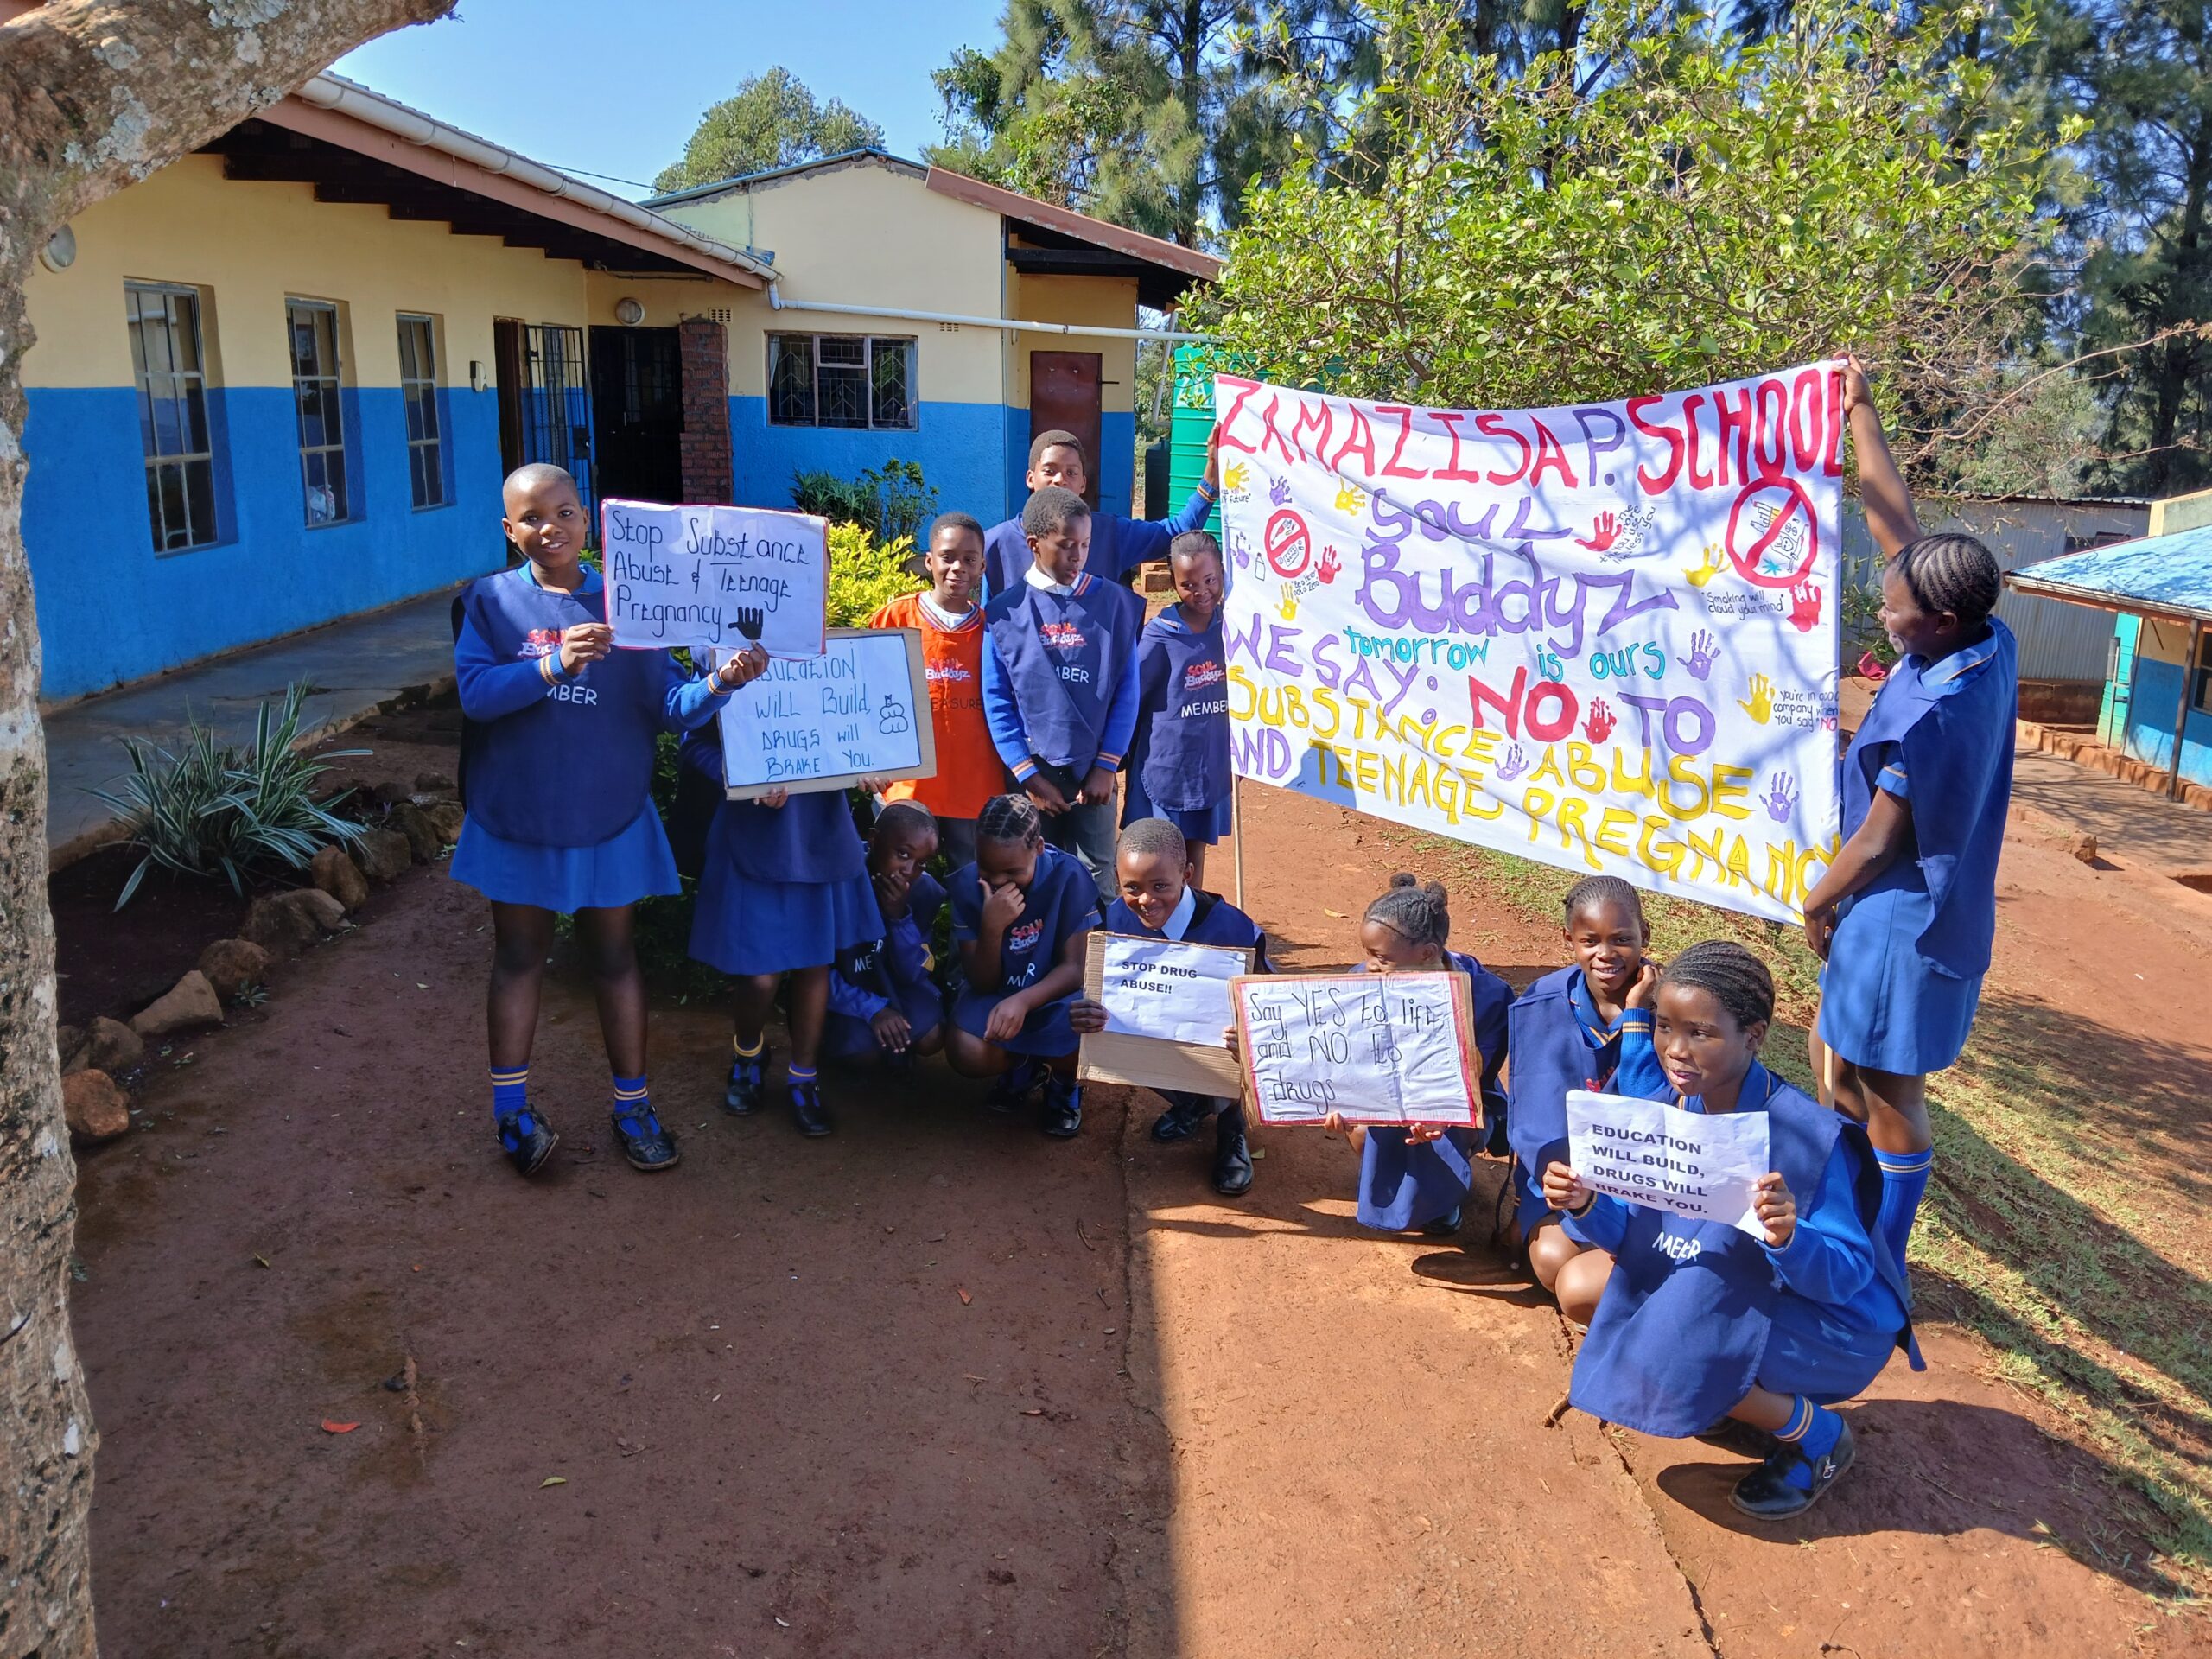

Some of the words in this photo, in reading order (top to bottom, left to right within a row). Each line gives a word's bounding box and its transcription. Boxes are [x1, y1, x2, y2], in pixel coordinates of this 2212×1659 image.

[1217, 375, 1579, 489] ZAMAZISA
[1627, 368, 1842, 495] SCHOOL
[613, 510, 663, 562] Stop
[687, 518, 810, 565] Substance
[613, 550, 679, 586] Abuse
[720, 568, 792, 613] Teenage
[1749, 589, 1765, 602] will
[617, 584, 722, 644] Pregnancy
[1707, 603, 1735, 614] cloud
[1738, 605, 1758, 621] your
[1224, 612, 1303, 677] WE
[1343, 625, 1490, 671] tomorrow
[1536, 645, 1565, 683] is
[1589, 640, 1667, 682] ours
[1181, 700, 1229, 719] MEMBE
[1469, 666, 1576, 743] NO
[1617, 692, 1716, 756] TO
[1773, 702, 1814, 719] company
[1808, 689, 1816, 702] in
[762, 729, 820, 752] DRUGS
[837, 723, 860, 743] will
[1796, 716, 1815, 733] say
[1229, 665, 1509, 764] SUBSTANCE
[1529, 741, 1757, 821] ABUSE
[765, 757, 821, 778] BRAKE
[1307, 737, 1504, 825] TEENAGE
[1120, 978, 1172, 994] ABUSE!!
[1122, 961, 1156, 972] STOP
[1160, 965, 1198, 979] DRUG
[1250, 993, 1283, 1040] Say
[1292, 988, 1346, 1027] YES
[1362, 995, 1388, 1023] to
[1402, 998, 1440, 1033] life
[1257, 1029, 1292, 1058] and
[1309, 1030, 1349, 1064] NO
[1370, 1033, 1402, 1065] to
[1592, 1123, 1701, 1155] EDUCATION
[1592, 1145, 1637, 1163] WILL
[1643, 1154, 1705, 1179] BUILD,
[1593, 1165, 1656, 1187] DRUGS
[1662, 1179, 1708, 1197] WILL
[1595, 1183, 1656, 1203] BRAKE
[1662, 1197, 1708, 1214] YOU.
